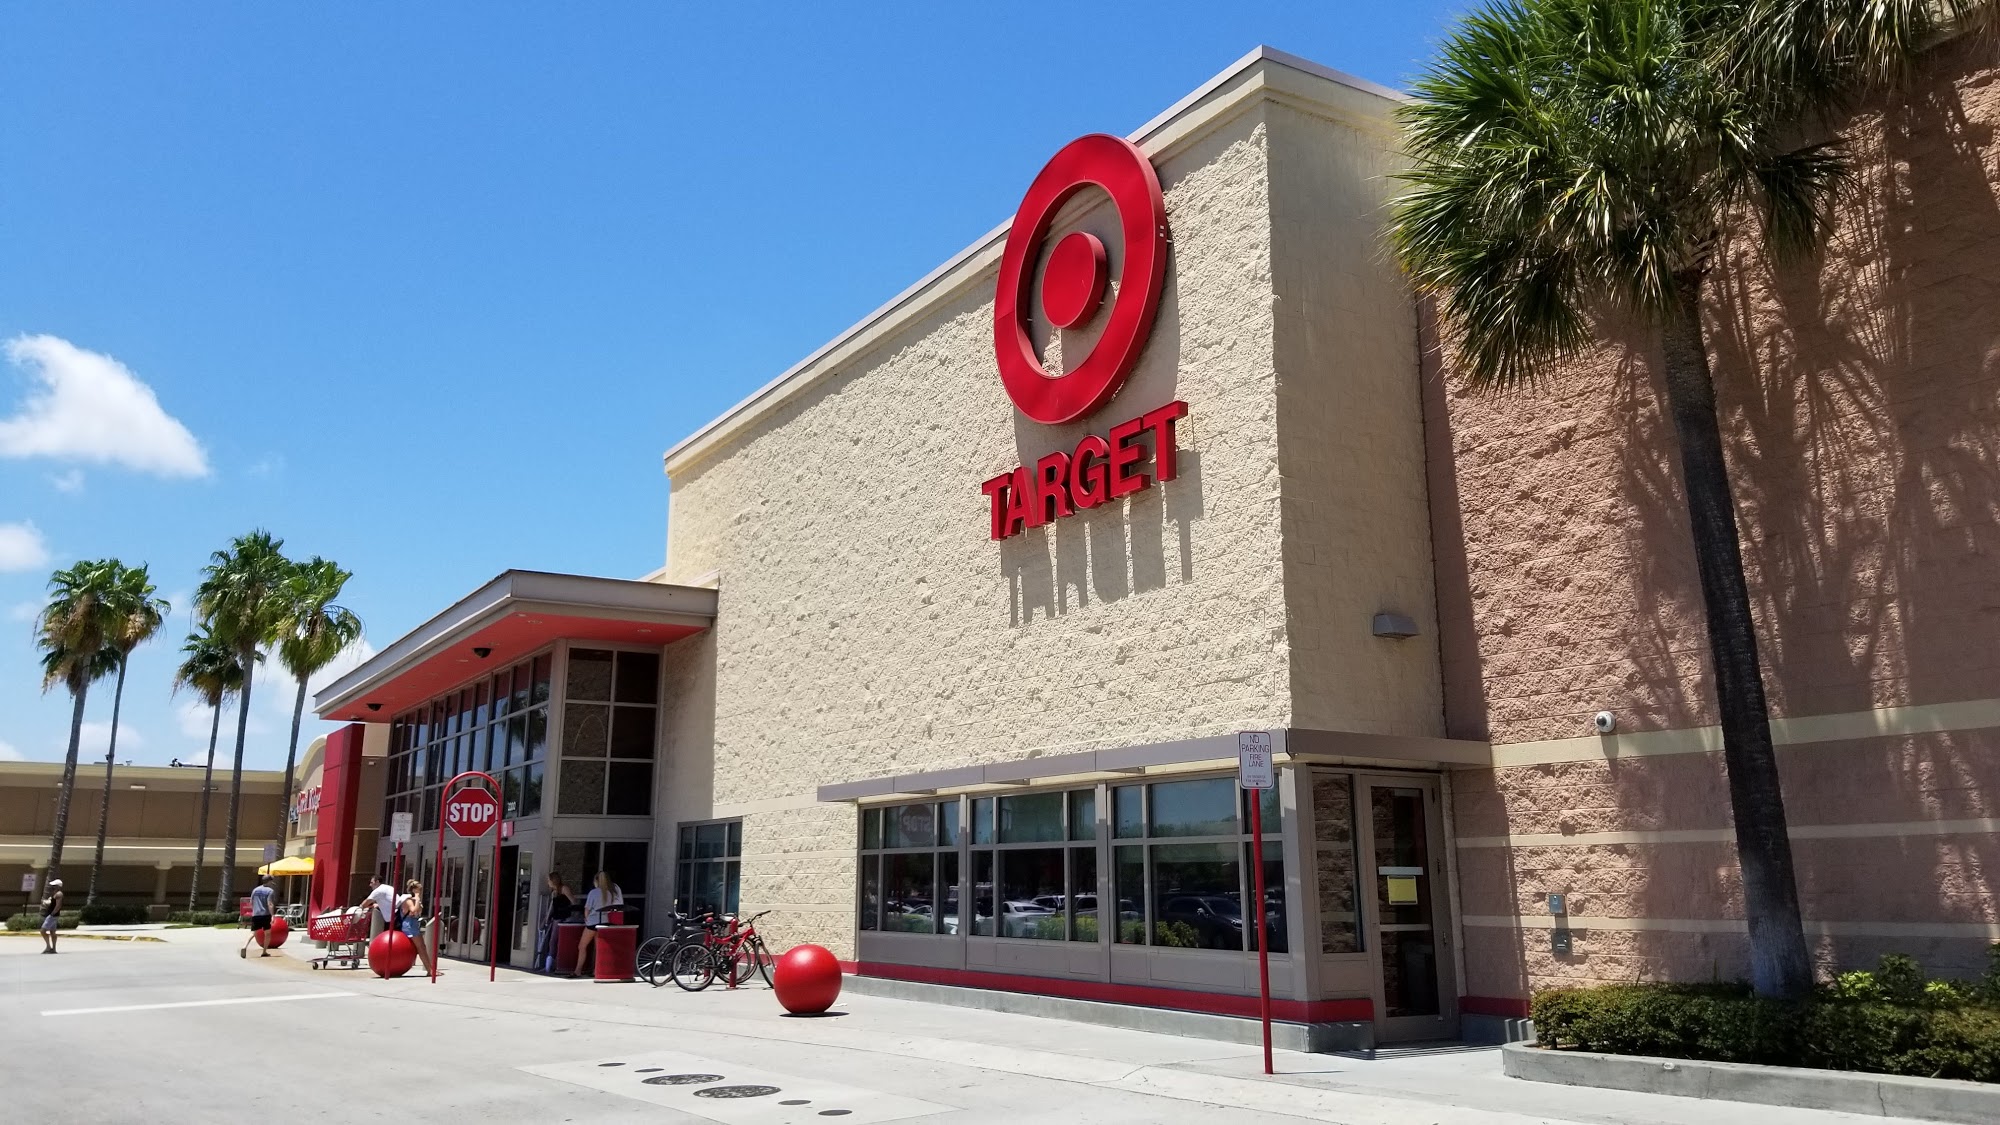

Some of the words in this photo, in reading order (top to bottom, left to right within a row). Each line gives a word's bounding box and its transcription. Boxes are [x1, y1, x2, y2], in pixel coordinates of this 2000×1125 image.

[982, 400, 1188, 541] TARGET
[1249, 735, 1260, 743] NO
[1242, 744, 1269, 753] PARKING
[450, 803, 494, 823] STOP
